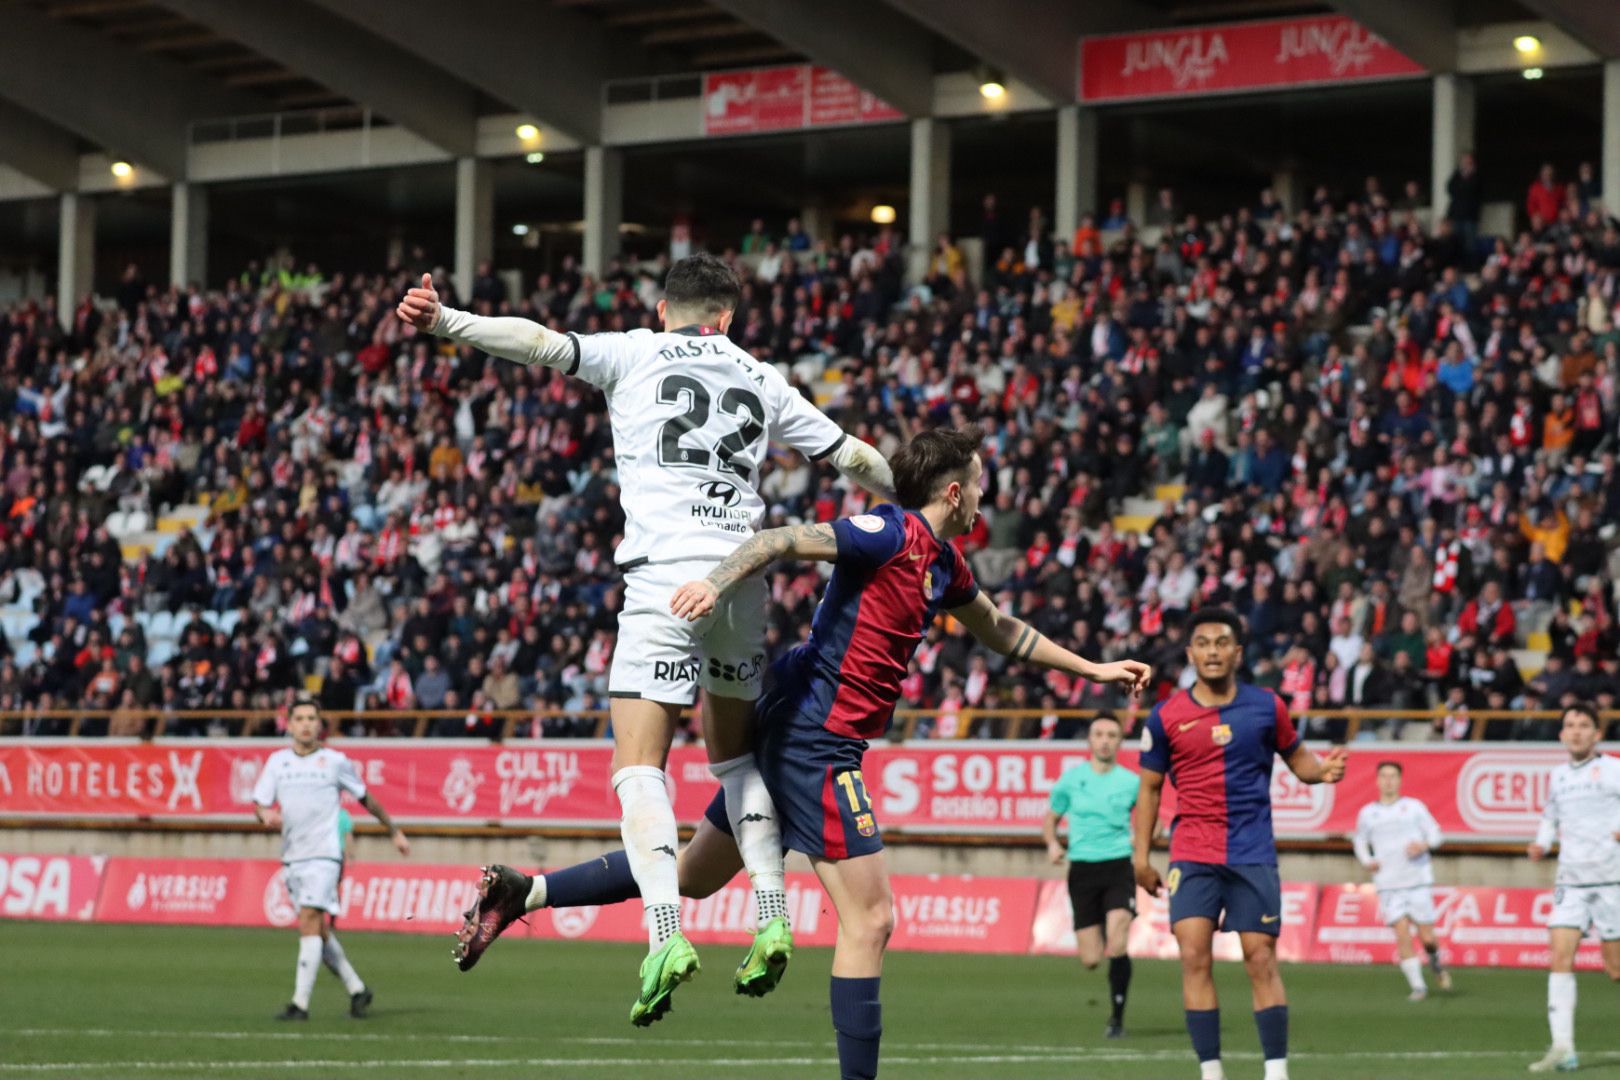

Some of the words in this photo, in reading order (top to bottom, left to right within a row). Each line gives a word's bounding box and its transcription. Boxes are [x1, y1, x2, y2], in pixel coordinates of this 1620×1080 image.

[656, 374, 766, 482] 22
[495, 751, 580, 779] CULTU
[27, 761, 165, 798] HOTELES
[148, 874, 228, 900] VERSUS
[900, 896, 1000, 923] VERSUS
